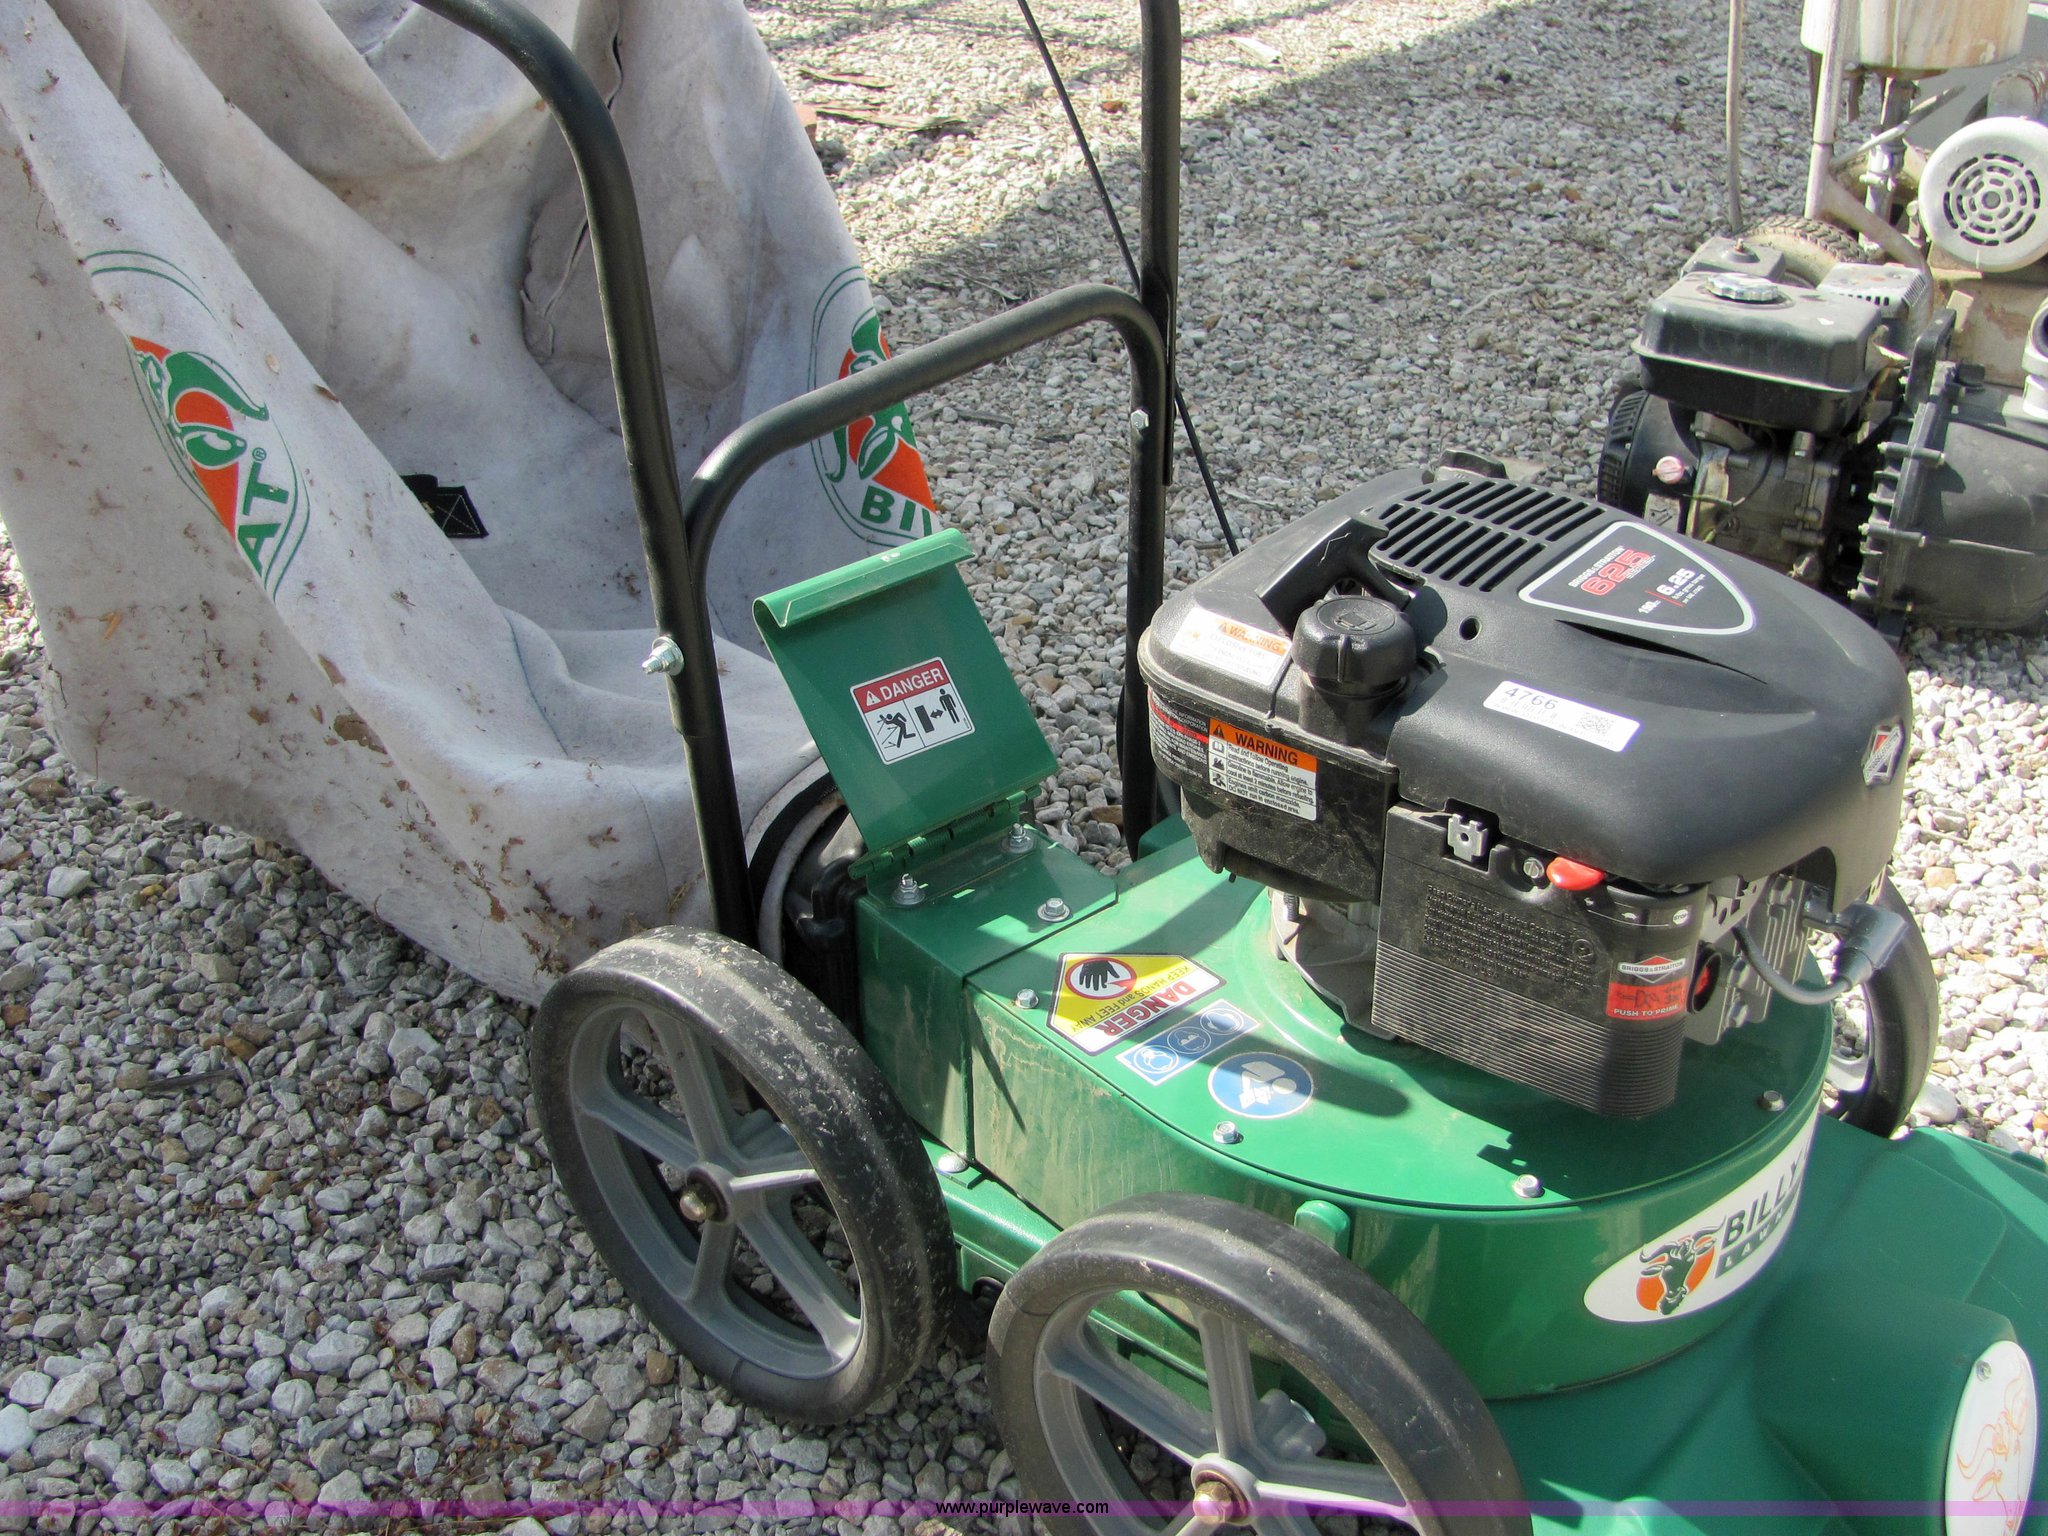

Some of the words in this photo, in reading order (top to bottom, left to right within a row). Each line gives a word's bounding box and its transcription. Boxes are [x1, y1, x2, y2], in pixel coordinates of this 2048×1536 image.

[1581, 549, 1651, 596] 625
[1656, 568, 1695, 595] 6.25
[1229, 625, 1280, 651] WAING
[880, 667, 944, 701] DANGER
[1505, 687, 1558, 710] 4766
[1235, 732, 1298, 765] WARNING
[1167, 965, 1190, 982] KEEP
[1133, 977, 1165, 997] HANDS
[1094, 980, 1197, 1037] DANGER
[1094, 1002, 1119, 1019] FEET
[1117, 993, 1134, 1009] and
[1613, 1008, 1639, 1017] PUSH
[1642, 1008, 1653, 1016] TO
[1655, 1004, 1679, 1015] PRIME
[1070, 1014, 1096, 1032] AWAY
